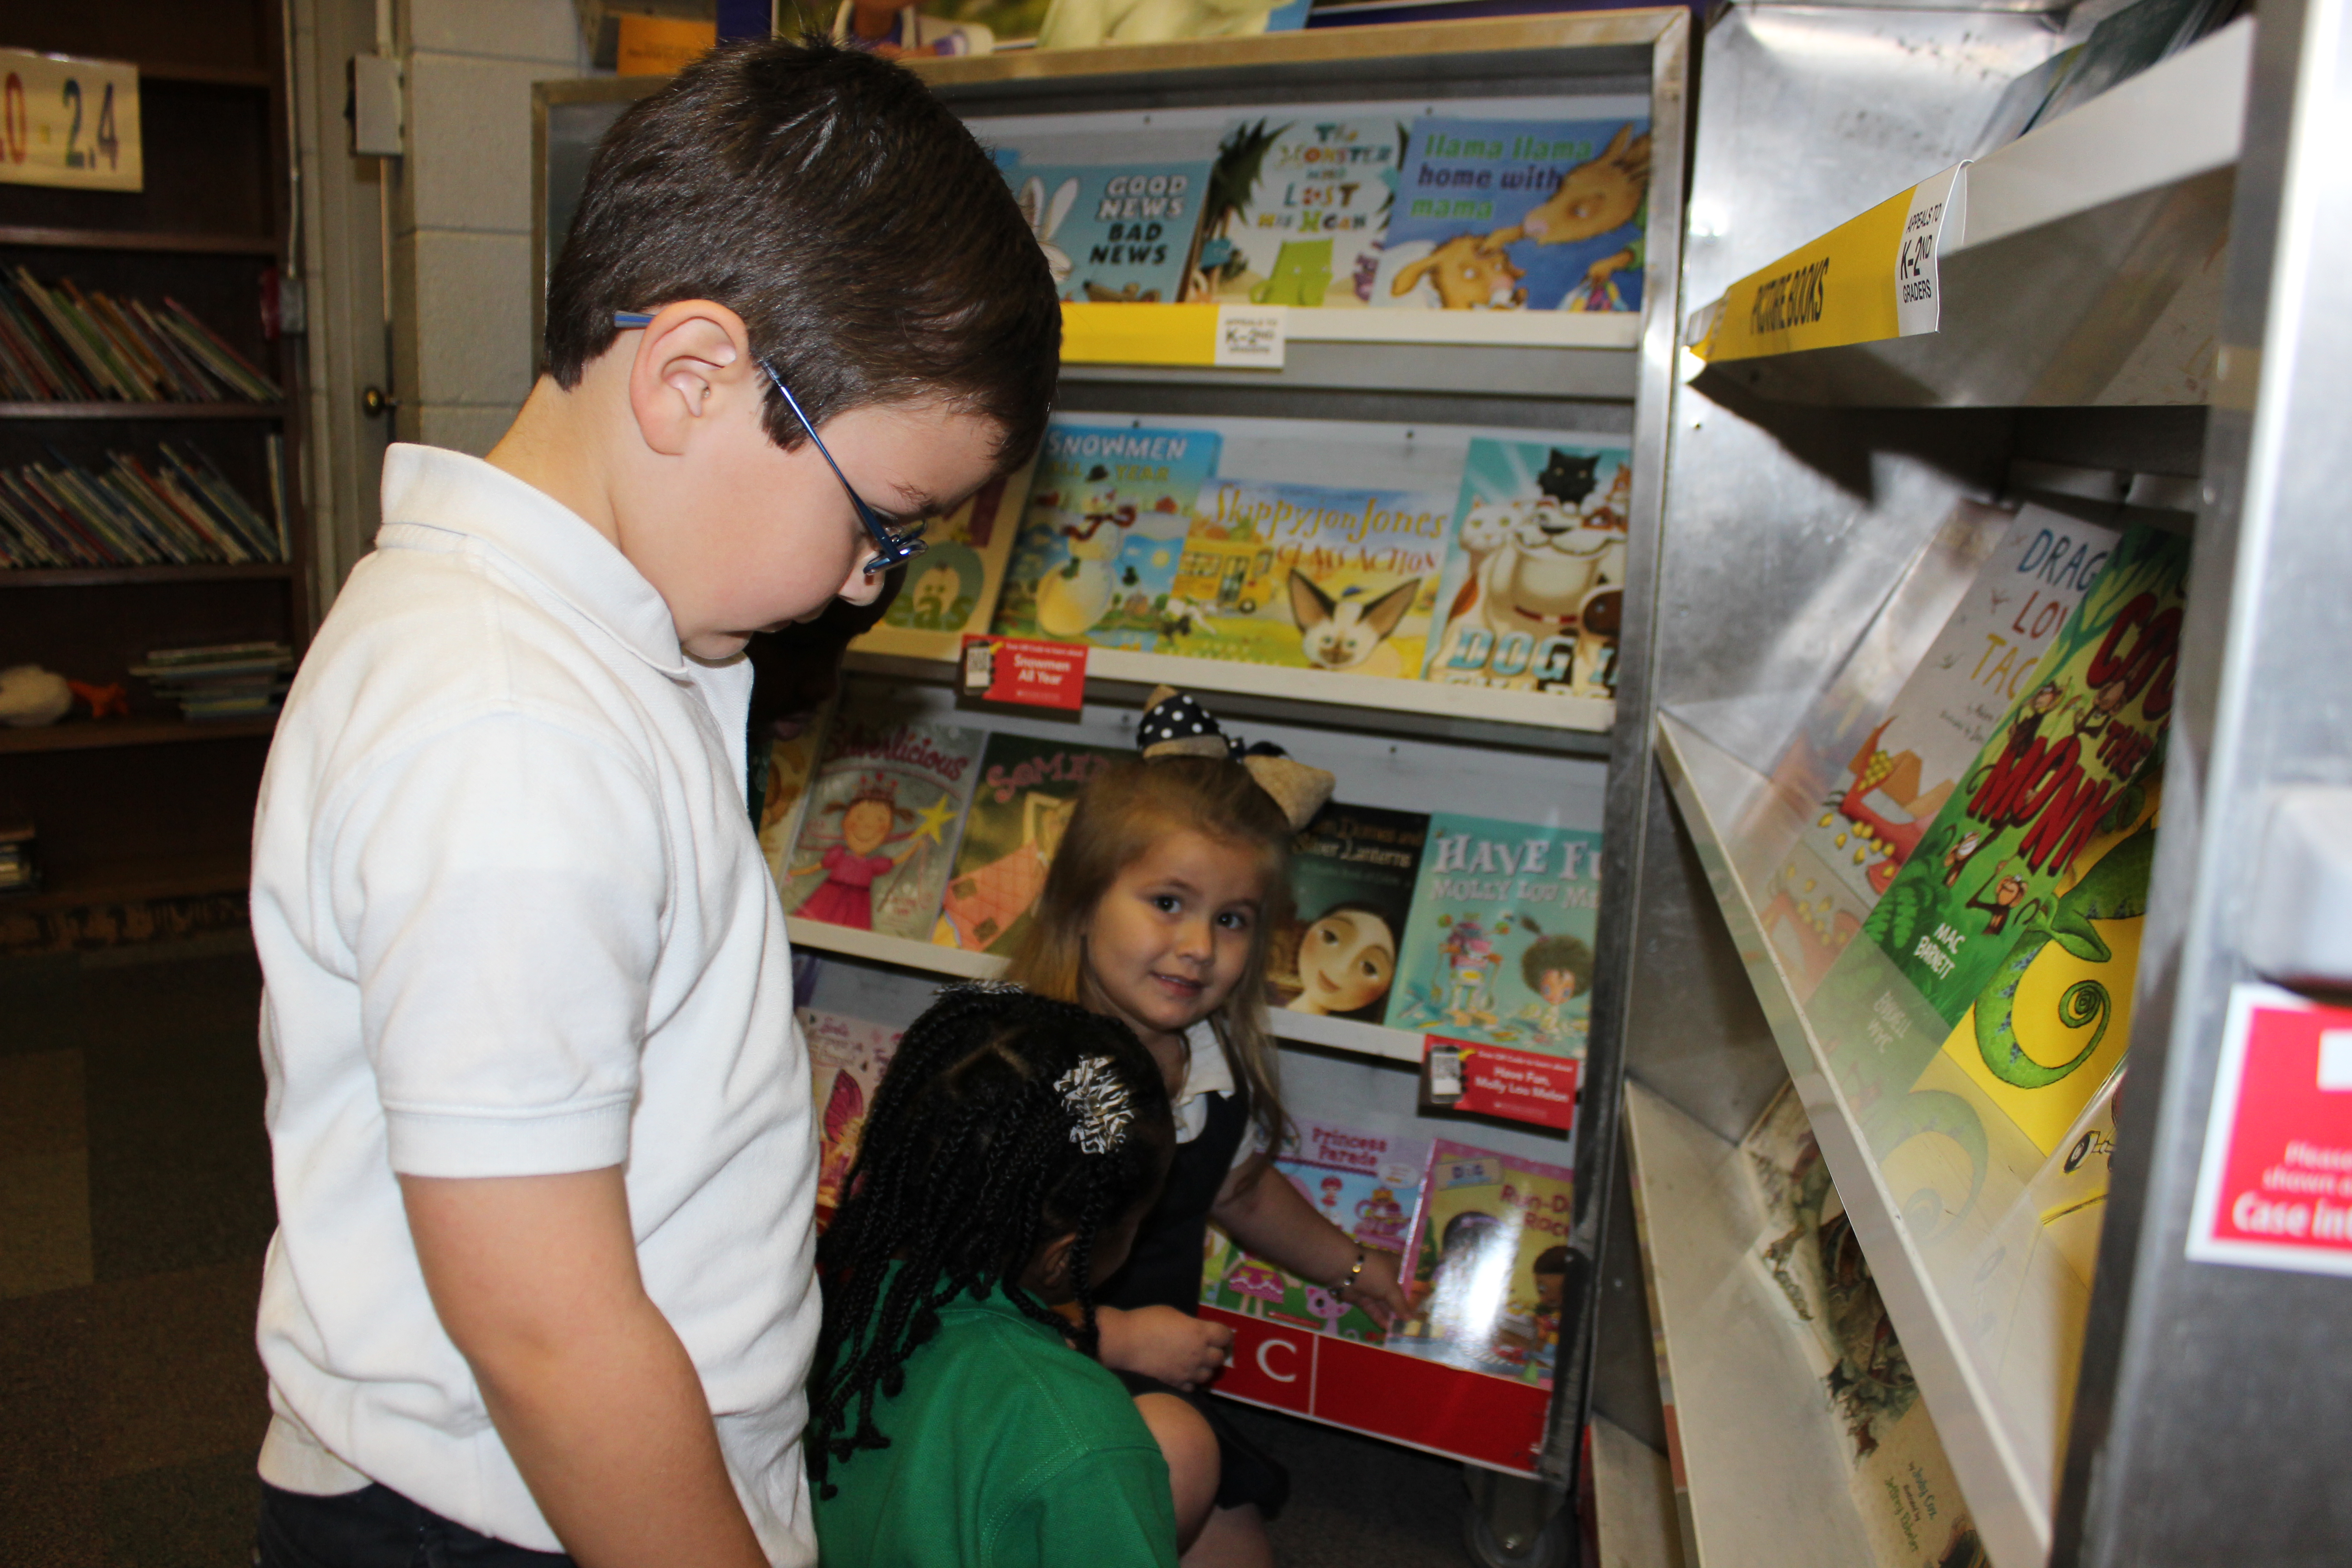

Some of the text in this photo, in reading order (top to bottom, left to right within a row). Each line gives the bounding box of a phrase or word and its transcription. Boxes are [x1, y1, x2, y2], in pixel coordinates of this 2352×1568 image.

[62, 77, 119, 171] 2.4
[1425, 133, 1592, 161] llama llama
[1106, 175, 1188, 196] GOOD
[1418, 162, 1492, 189] home
[1096, 197, 1184, 220] NEWS
[1411, 199, 1493, 220] mama
[1906, 203, 1942, 234] APPEALS TO
[1109, 223, 1162, 242] BAD
[1090, 244, 1168, 265] NEWS
[1787, 256, 1830, 328] BOOKS
[1903, 279, 1932, 304] GRADERS
[1014, 653, 1071, 672] Snowmen
[1446, 627, 1576, 681] DOG
[1018, 668, 1034, 682] All
[1432, 833, 1551, 877] HAVE
[1933, 922, 1966, 955] MAC
[1913, 935, 1955, 980] BARNETT
[1494, 1066, 1524, 1082] Have
[1475, 1075, 1570, 1103] Molly Lou Melon
